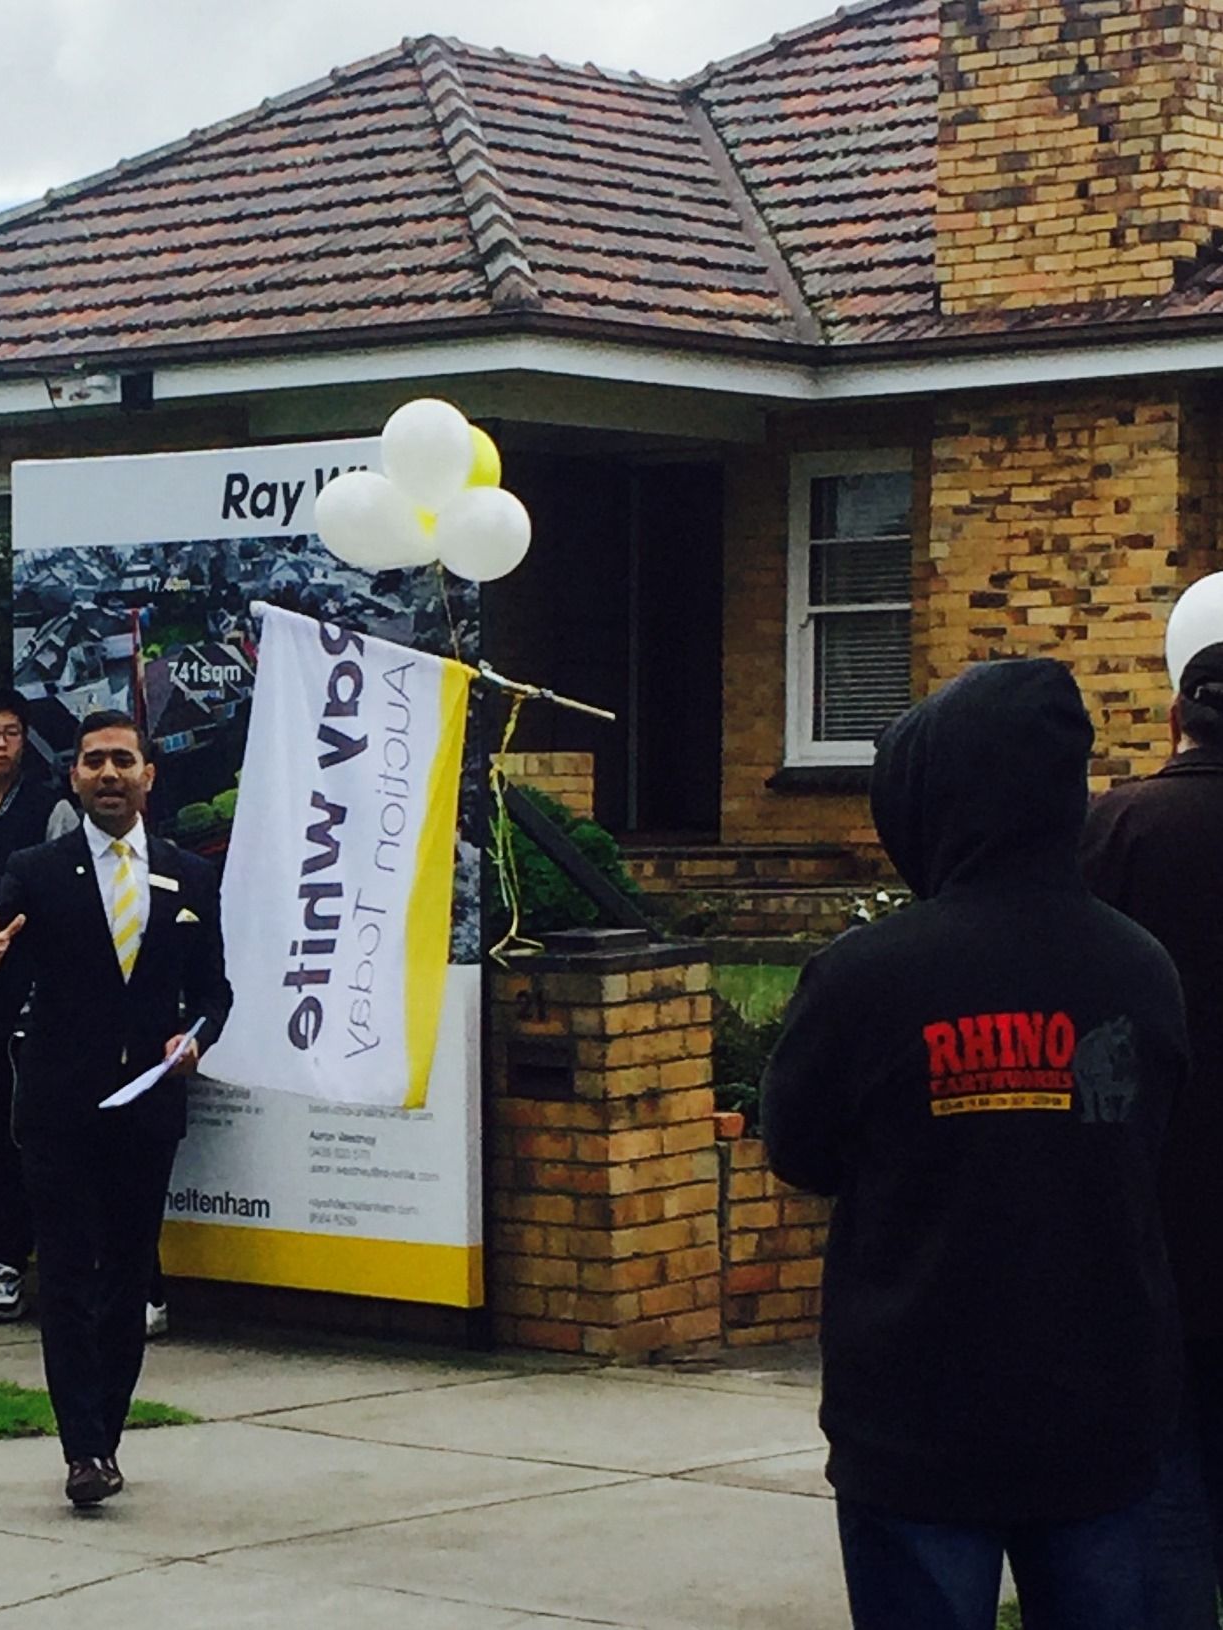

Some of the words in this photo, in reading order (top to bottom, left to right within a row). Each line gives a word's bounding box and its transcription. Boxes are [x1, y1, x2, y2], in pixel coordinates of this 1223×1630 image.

[222, 473, 305, 526] Ray
[168, 661, 242, 687] 741sqm
[922, 1011, 1075, 1076] RHINO
